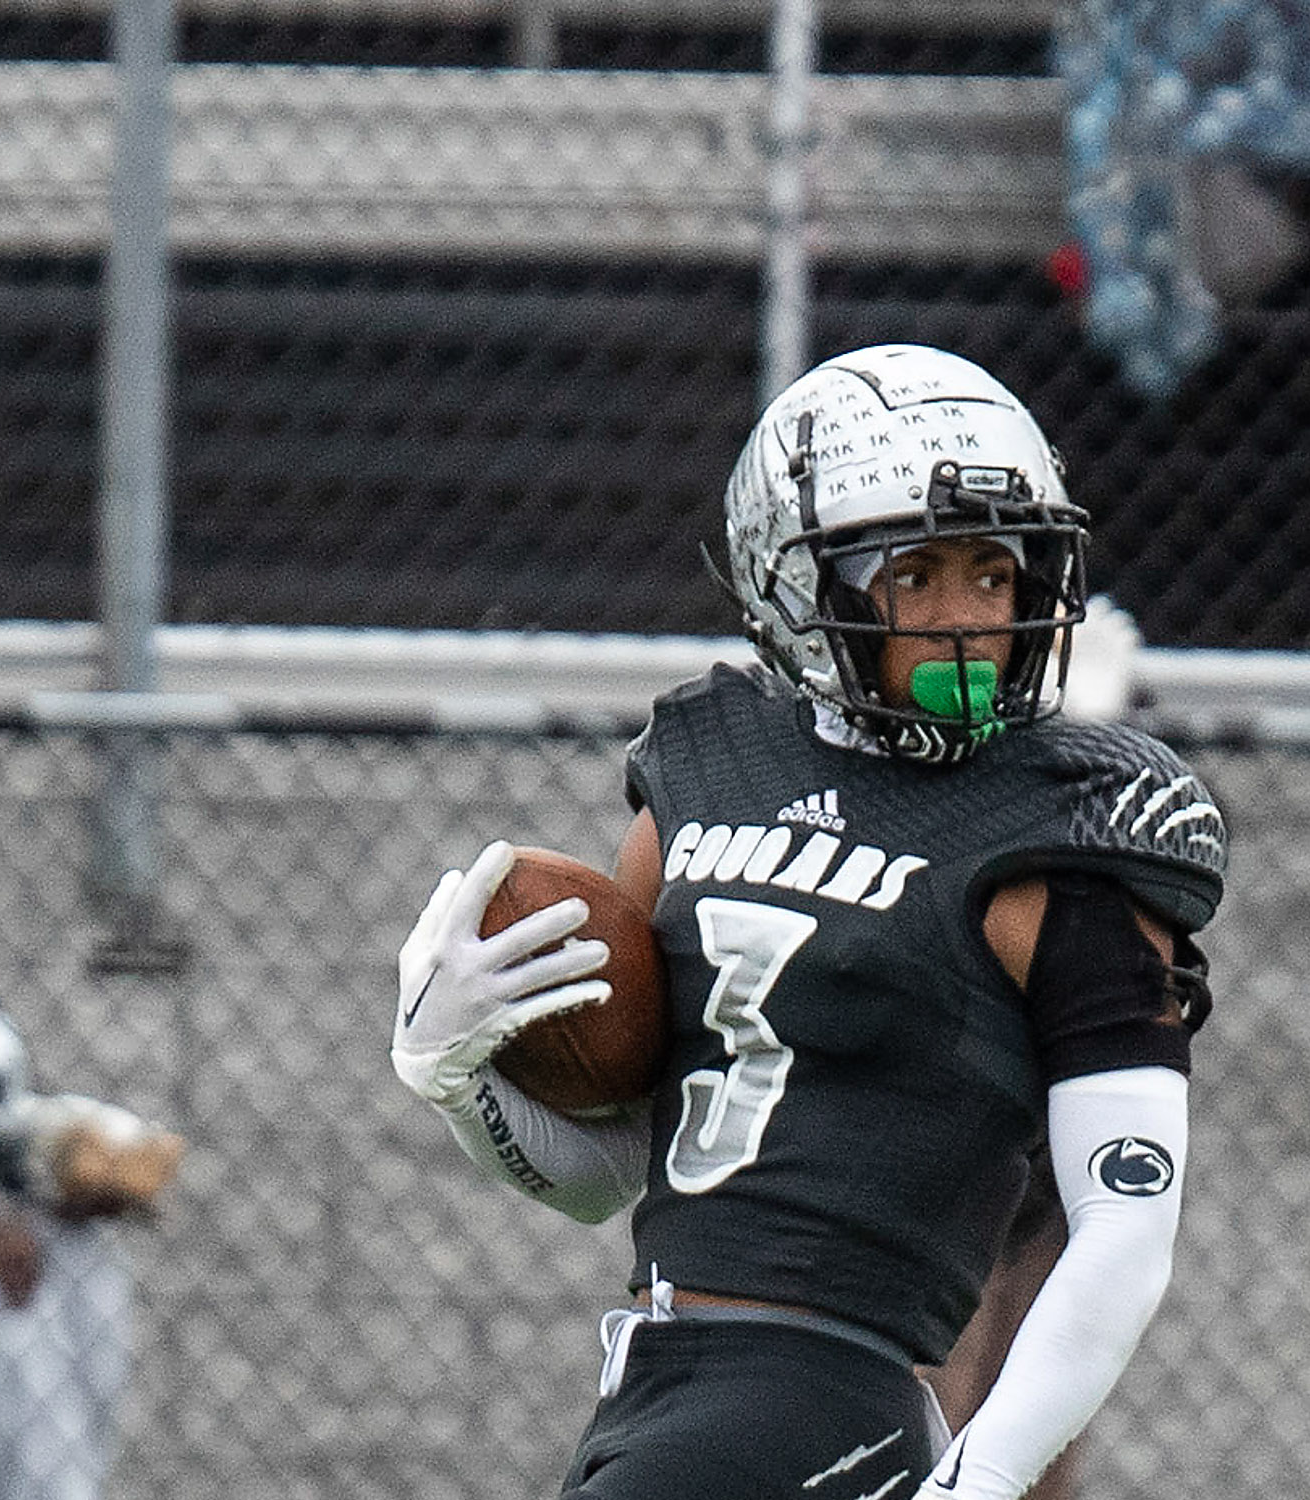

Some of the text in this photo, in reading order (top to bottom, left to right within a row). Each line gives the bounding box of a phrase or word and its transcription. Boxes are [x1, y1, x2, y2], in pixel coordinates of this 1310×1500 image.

[822, 407, 874, 436] 1K 1K
[901, 405, 965, 426] 1K 1K
[834, 440, 853, 457] 1K
[870, 431, 891, 447] 1K
[921, 433, 980, 451] 1K 1K
[828, 461, 915, 496] 1K 1K 1K
[777, 806, 847, 832] adidas
[664, 821, 930, 911] COUGARS
[665, 897, 818, 1194] 3
[476, 1081, 554, 1194] PENN STATE
